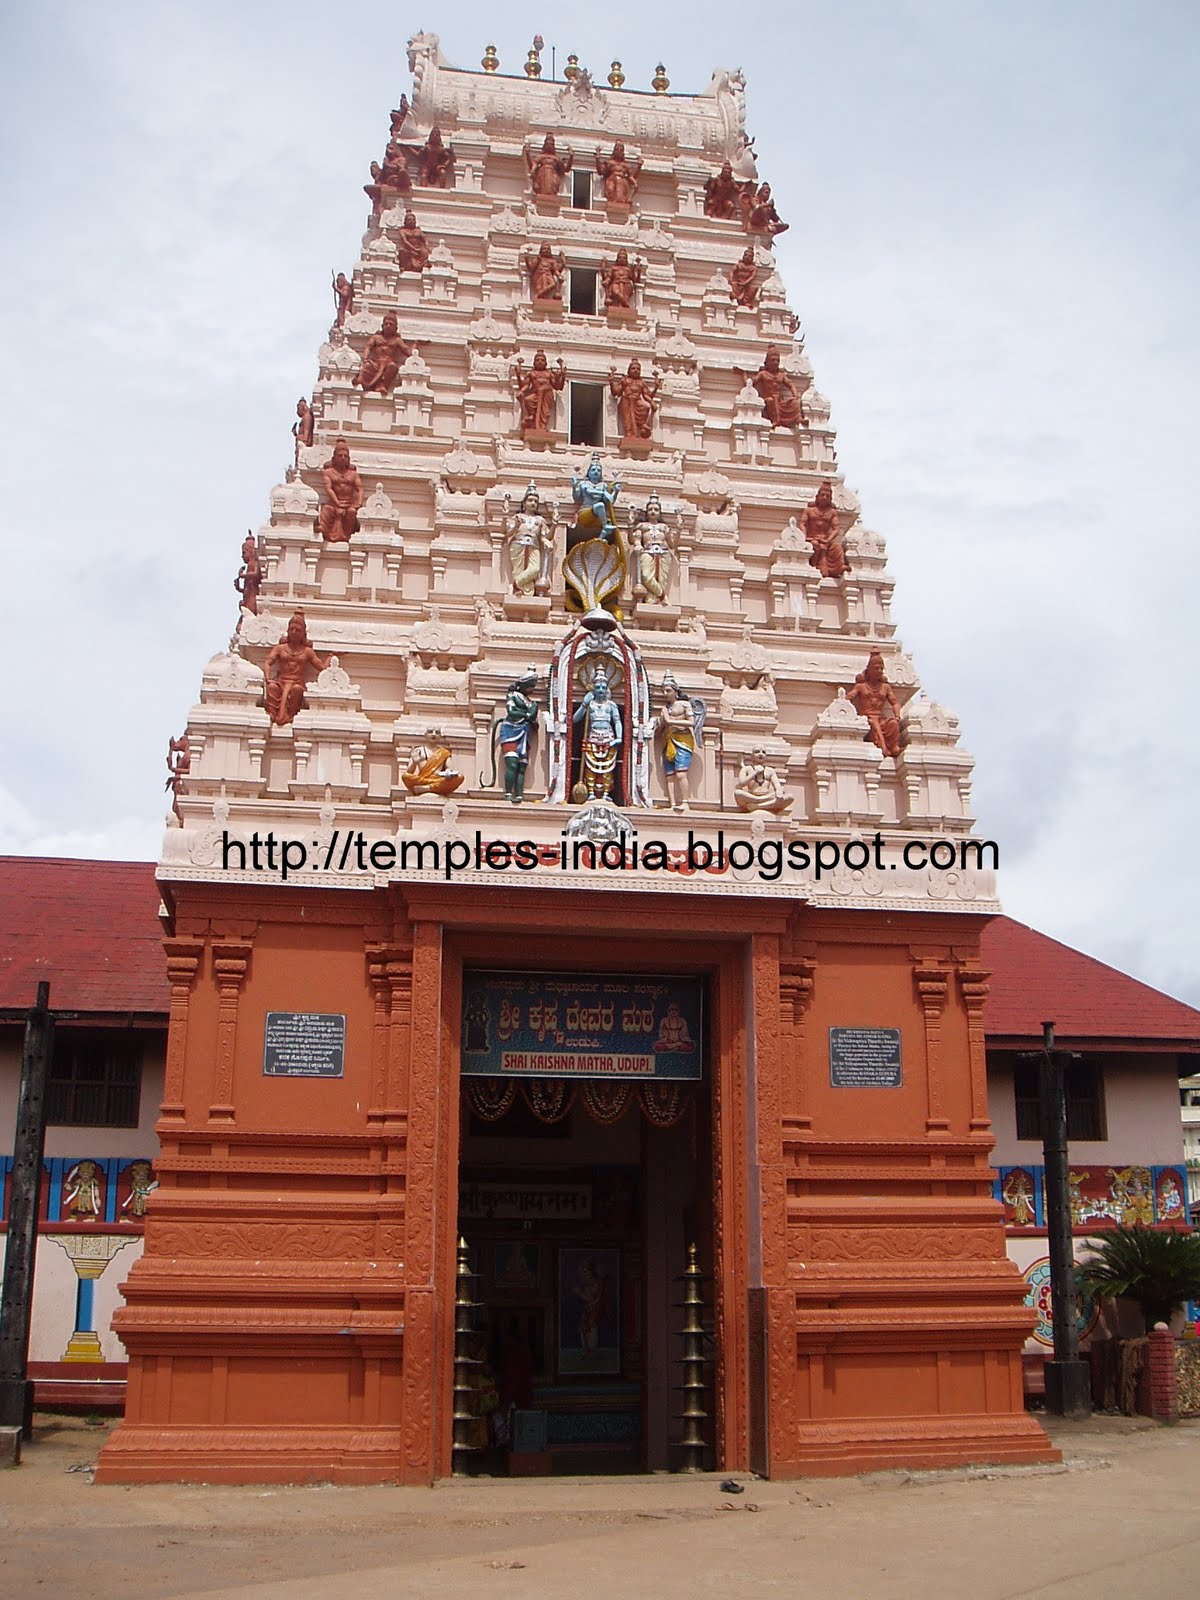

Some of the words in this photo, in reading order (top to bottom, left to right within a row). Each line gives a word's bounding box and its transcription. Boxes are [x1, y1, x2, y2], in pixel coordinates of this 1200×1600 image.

[498, 998, 521, 1041] ಶ್ರೀ
[529, 999, 565, 1044] ಕೃಷ್ಣ
[566, 999, 615, 1032] ದೇವರ
[622, 1001, 655, 1033] ಮಠ
[504, 1055, 528, 1069] SHRI
[530, 1056, 575, 1070] KRISHNA
[577, 1056, 616, 1072] MATHA,
